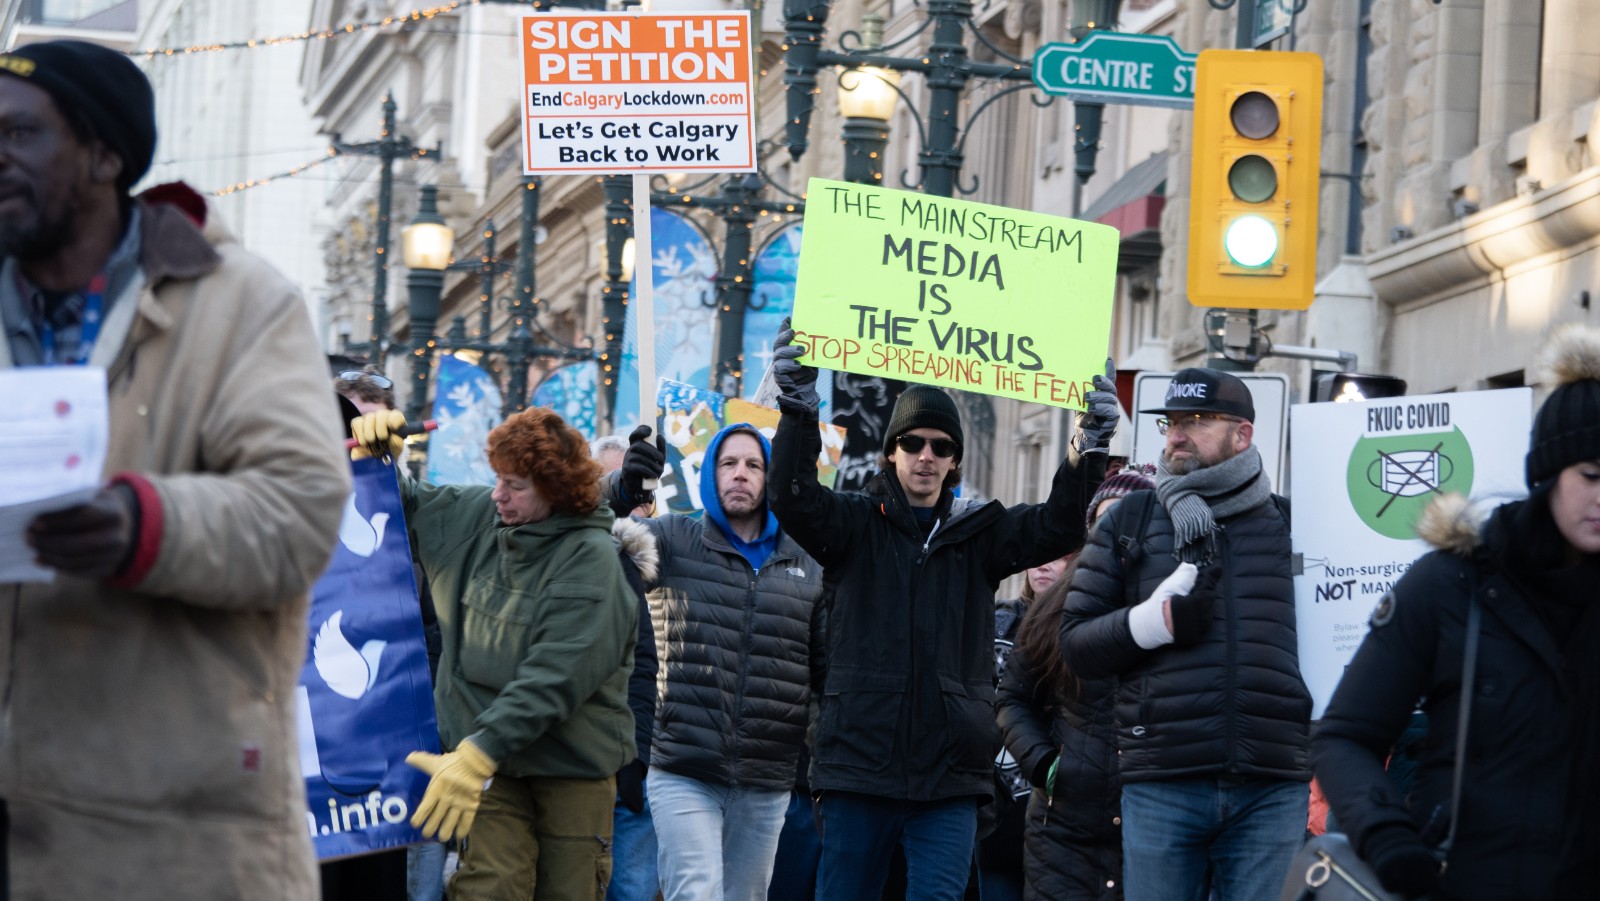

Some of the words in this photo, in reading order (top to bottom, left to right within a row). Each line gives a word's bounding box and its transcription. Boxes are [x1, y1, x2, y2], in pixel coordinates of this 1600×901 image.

[530, 20, 631, 49] SIGN
[656, 19, 741, 48] THE
[539, 52, 735, 81] PETITION
[1060, 56, 1153, 90] CENTRE
[1173, 64, 1196, 93] ST
[532, 91, 744, 109] EndCalgaryLockdown.com
[538, 121, 593, 139] Let's
[600, 122, 641, 139] Get
[649, 121, 739, 141] Calgary
[559, 146, 618, 163] Back
[625, 147, 649, 162] to
[656, 145, 720, 162] Work
[825, 187, 885, 221] THE
[901, 197, 1082, 263] MAINSTREAM
[882, 234, 1005, 291] MEDIA
[918, 280, 951, 315] IS
[849, 304, 919, 346] THE
[928, 319, 1044, 370] VIRUS
[793, 331, 861, 369] STOP
[866, 343, 983, 385] SPREADING
[991, 364, 1026, 392] THE
[1367, 405, 1403, 432] FKUC
[1407, 402, 1451, 429] COVID
[1325, 559, 1414, 578] Non-surgica
[1315, 579, 1356, 603] NOT
